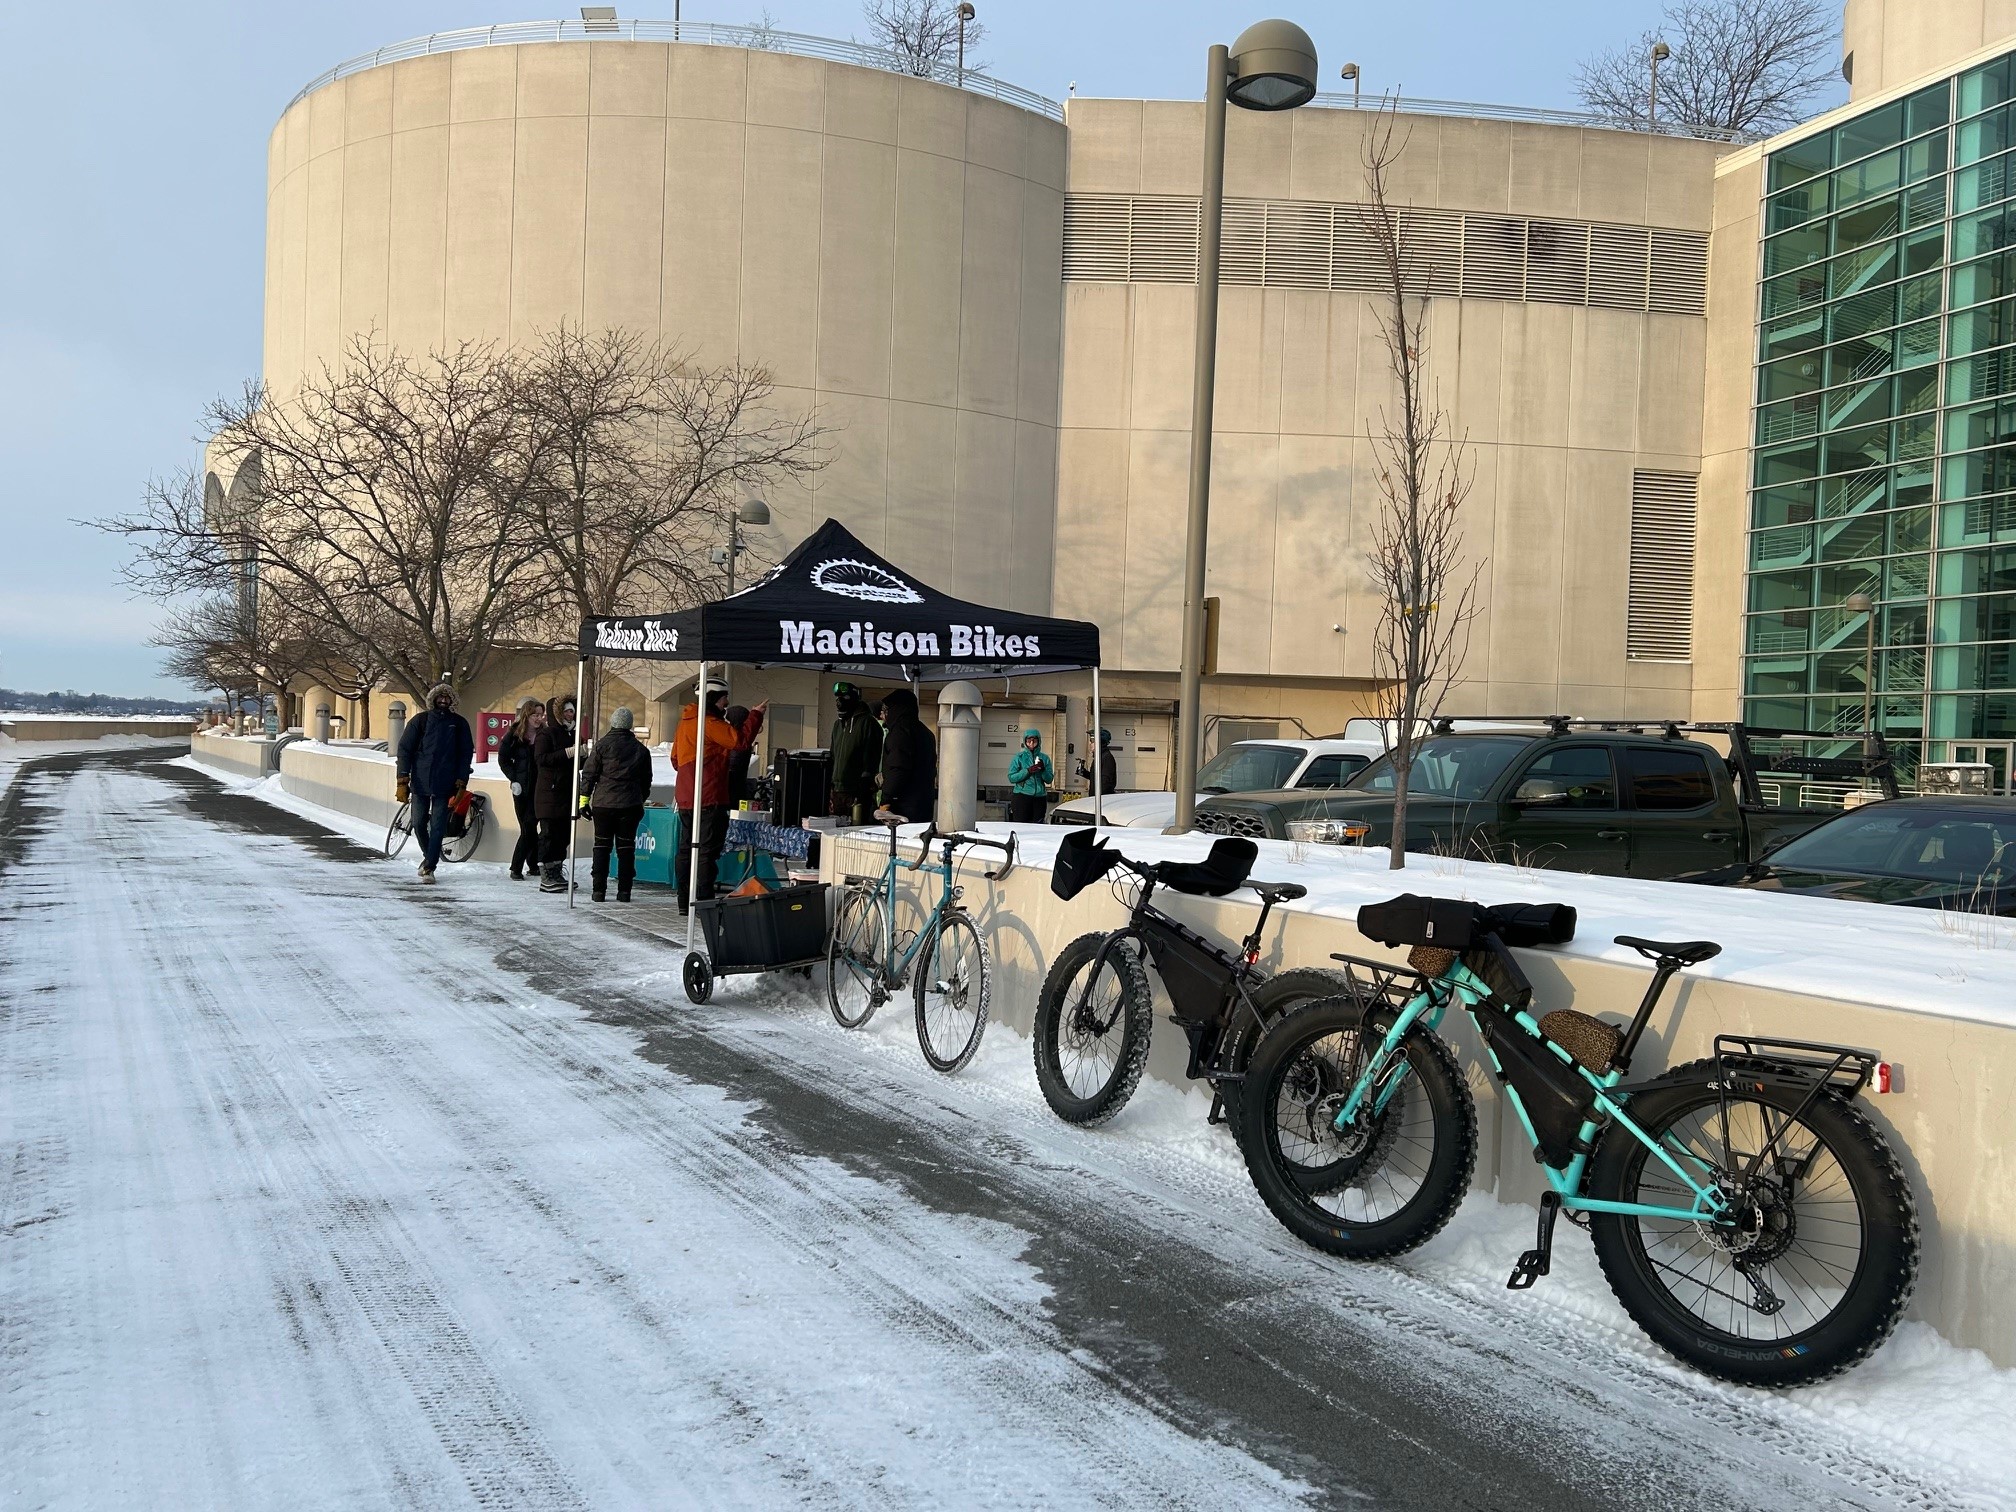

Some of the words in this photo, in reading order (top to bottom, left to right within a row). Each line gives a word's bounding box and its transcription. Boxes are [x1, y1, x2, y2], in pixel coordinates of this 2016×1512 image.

[595, 620, 644, 651] Madison
[643, 620, 679, 652] Bikes
[779, 620, 940, 656] Madison
[949, 625, 1041, 657] Bikes
[1007, 725, 1019, 733] E2
[1125, 728, 1137, 736] E3
[1697, 1338, 1784, 1362] VANHELGA
